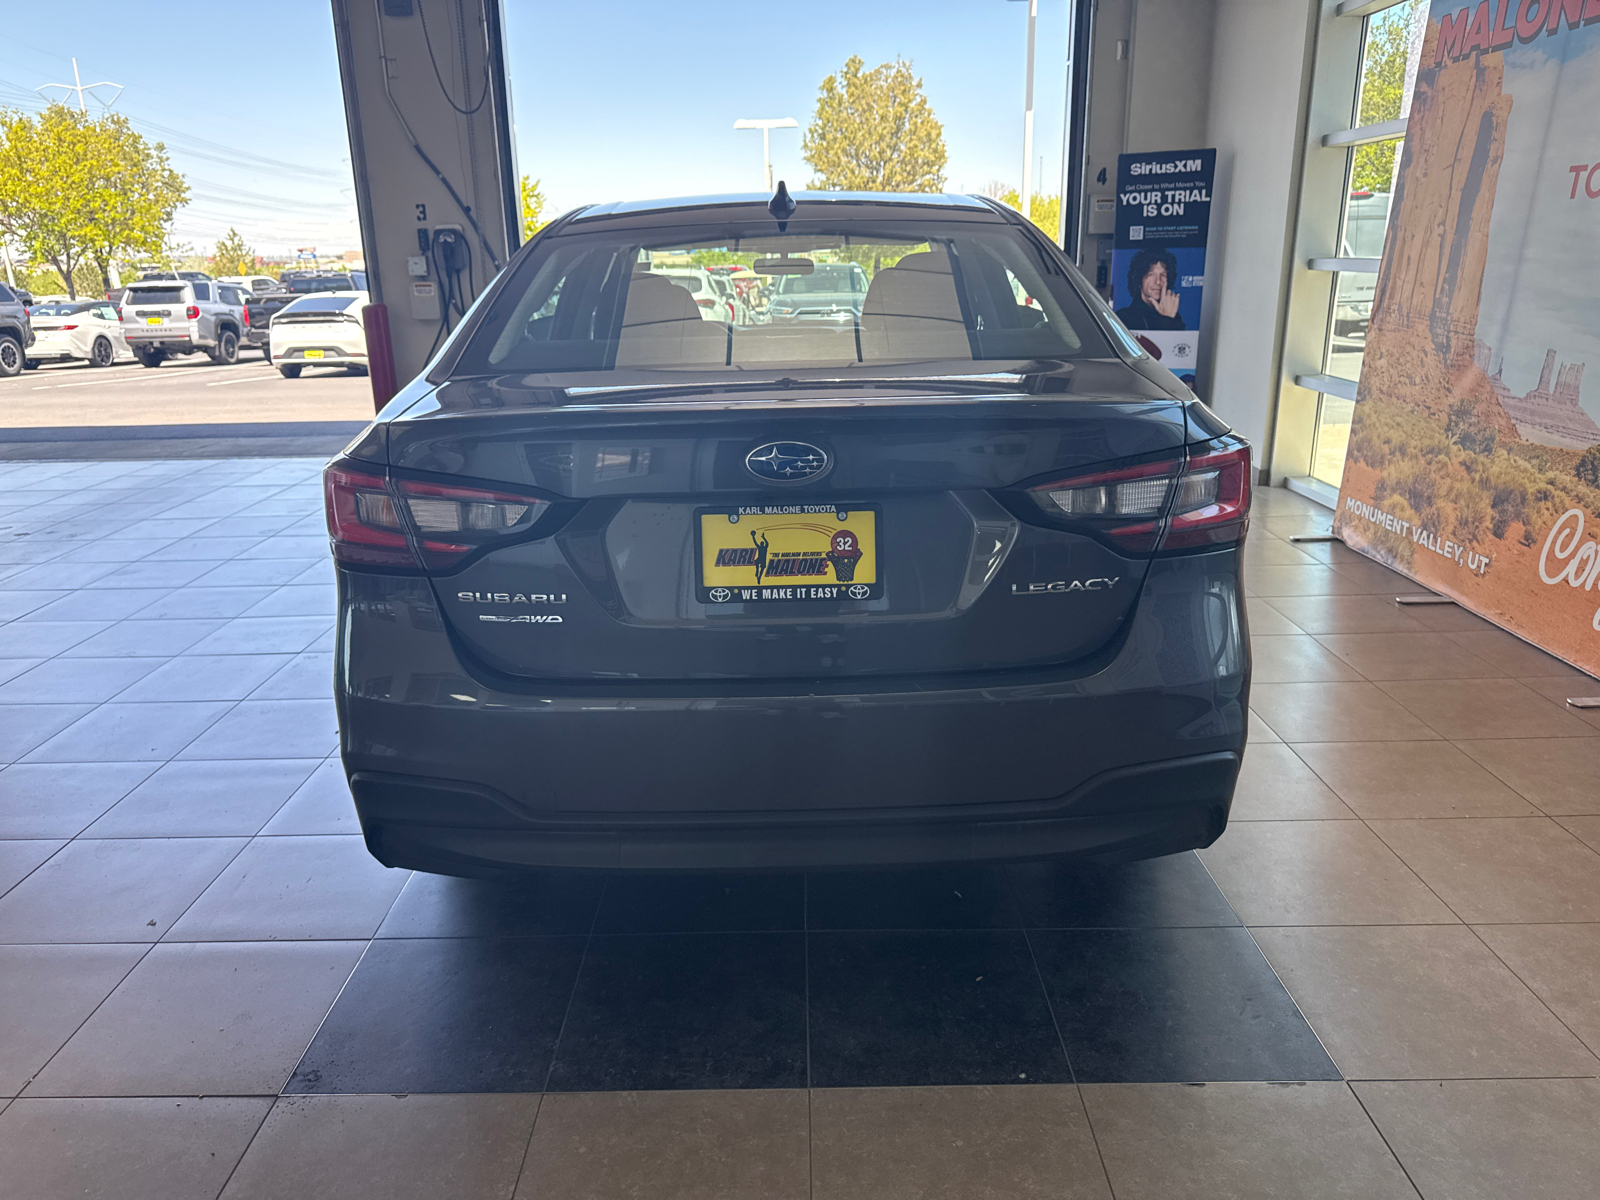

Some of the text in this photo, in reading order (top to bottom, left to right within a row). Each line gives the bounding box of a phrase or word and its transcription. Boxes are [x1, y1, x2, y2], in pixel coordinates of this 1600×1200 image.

[1096, 167, 1107, 185] 4
[1130, 159, 1202, 176] SiriusXM
[1136, 183, 1153, 191] Closer
[1160, 181, 1175, 189] What
[1119, 188, 1211, 206] YOUR TRIAL
[415, 203, 427, 221] 3
[1142, 203, 1185, 217] IS ON
[738, 504, 837, 515] KARL MALONE TOYOTA
[1345, 496, 1490, 574] MONUMENT VALLEY, UT
[836, 537, 852, 551] 32
[715, 548, 757, 567] KARL
[764, 557, 829, 577] MALONE
[741, 587, 838, 600] WE MAKE IT EASY
[1011, 576, 1120, 595] LEGACY
[457, 591, 567, 604] SUBARU
[510, 615, 564, 623] AWD
